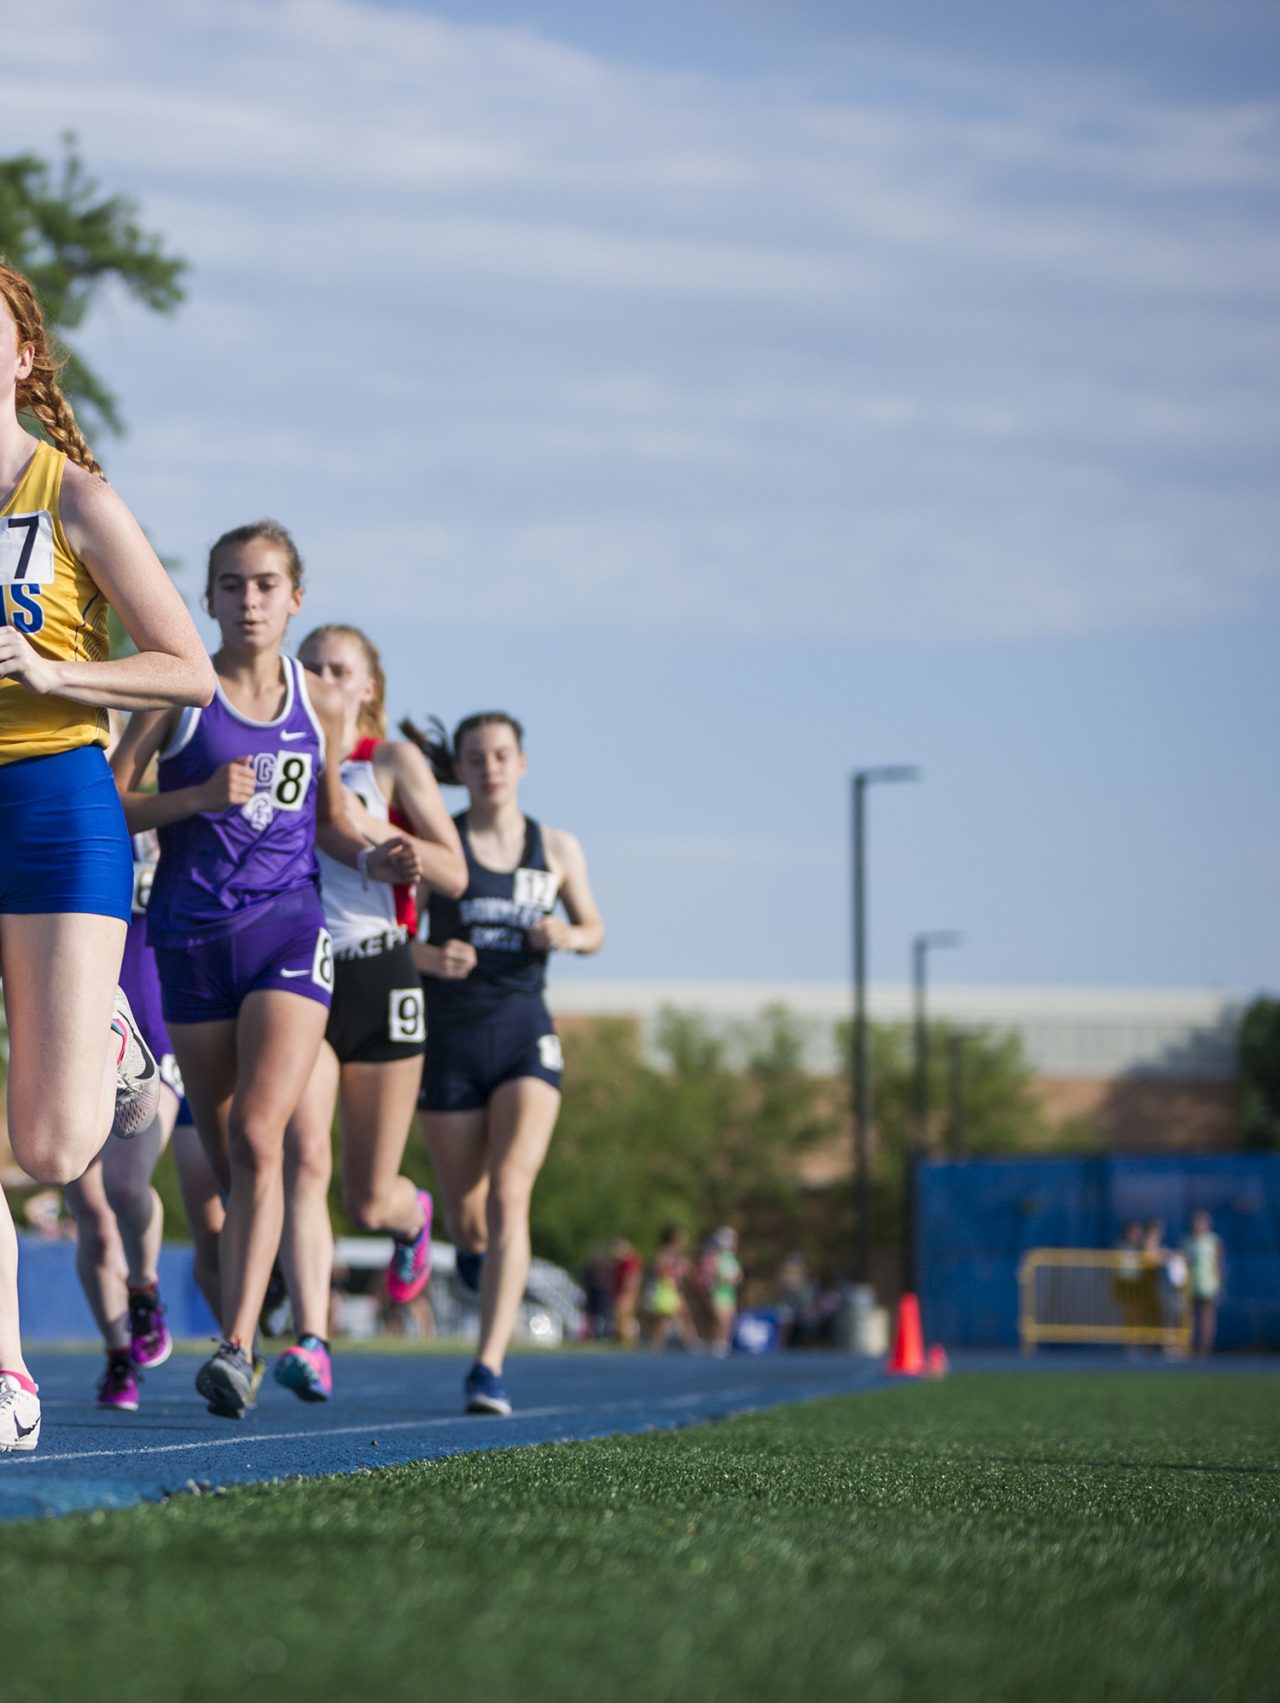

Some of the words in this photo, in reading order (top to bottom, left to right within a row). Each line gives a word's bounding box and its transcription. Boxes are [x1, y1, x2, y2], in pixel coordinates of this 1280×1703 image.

[8, 515, 39, 579] 7
[276, 758, 304, 804] 8
[399, 996, 418, 1035] 9
